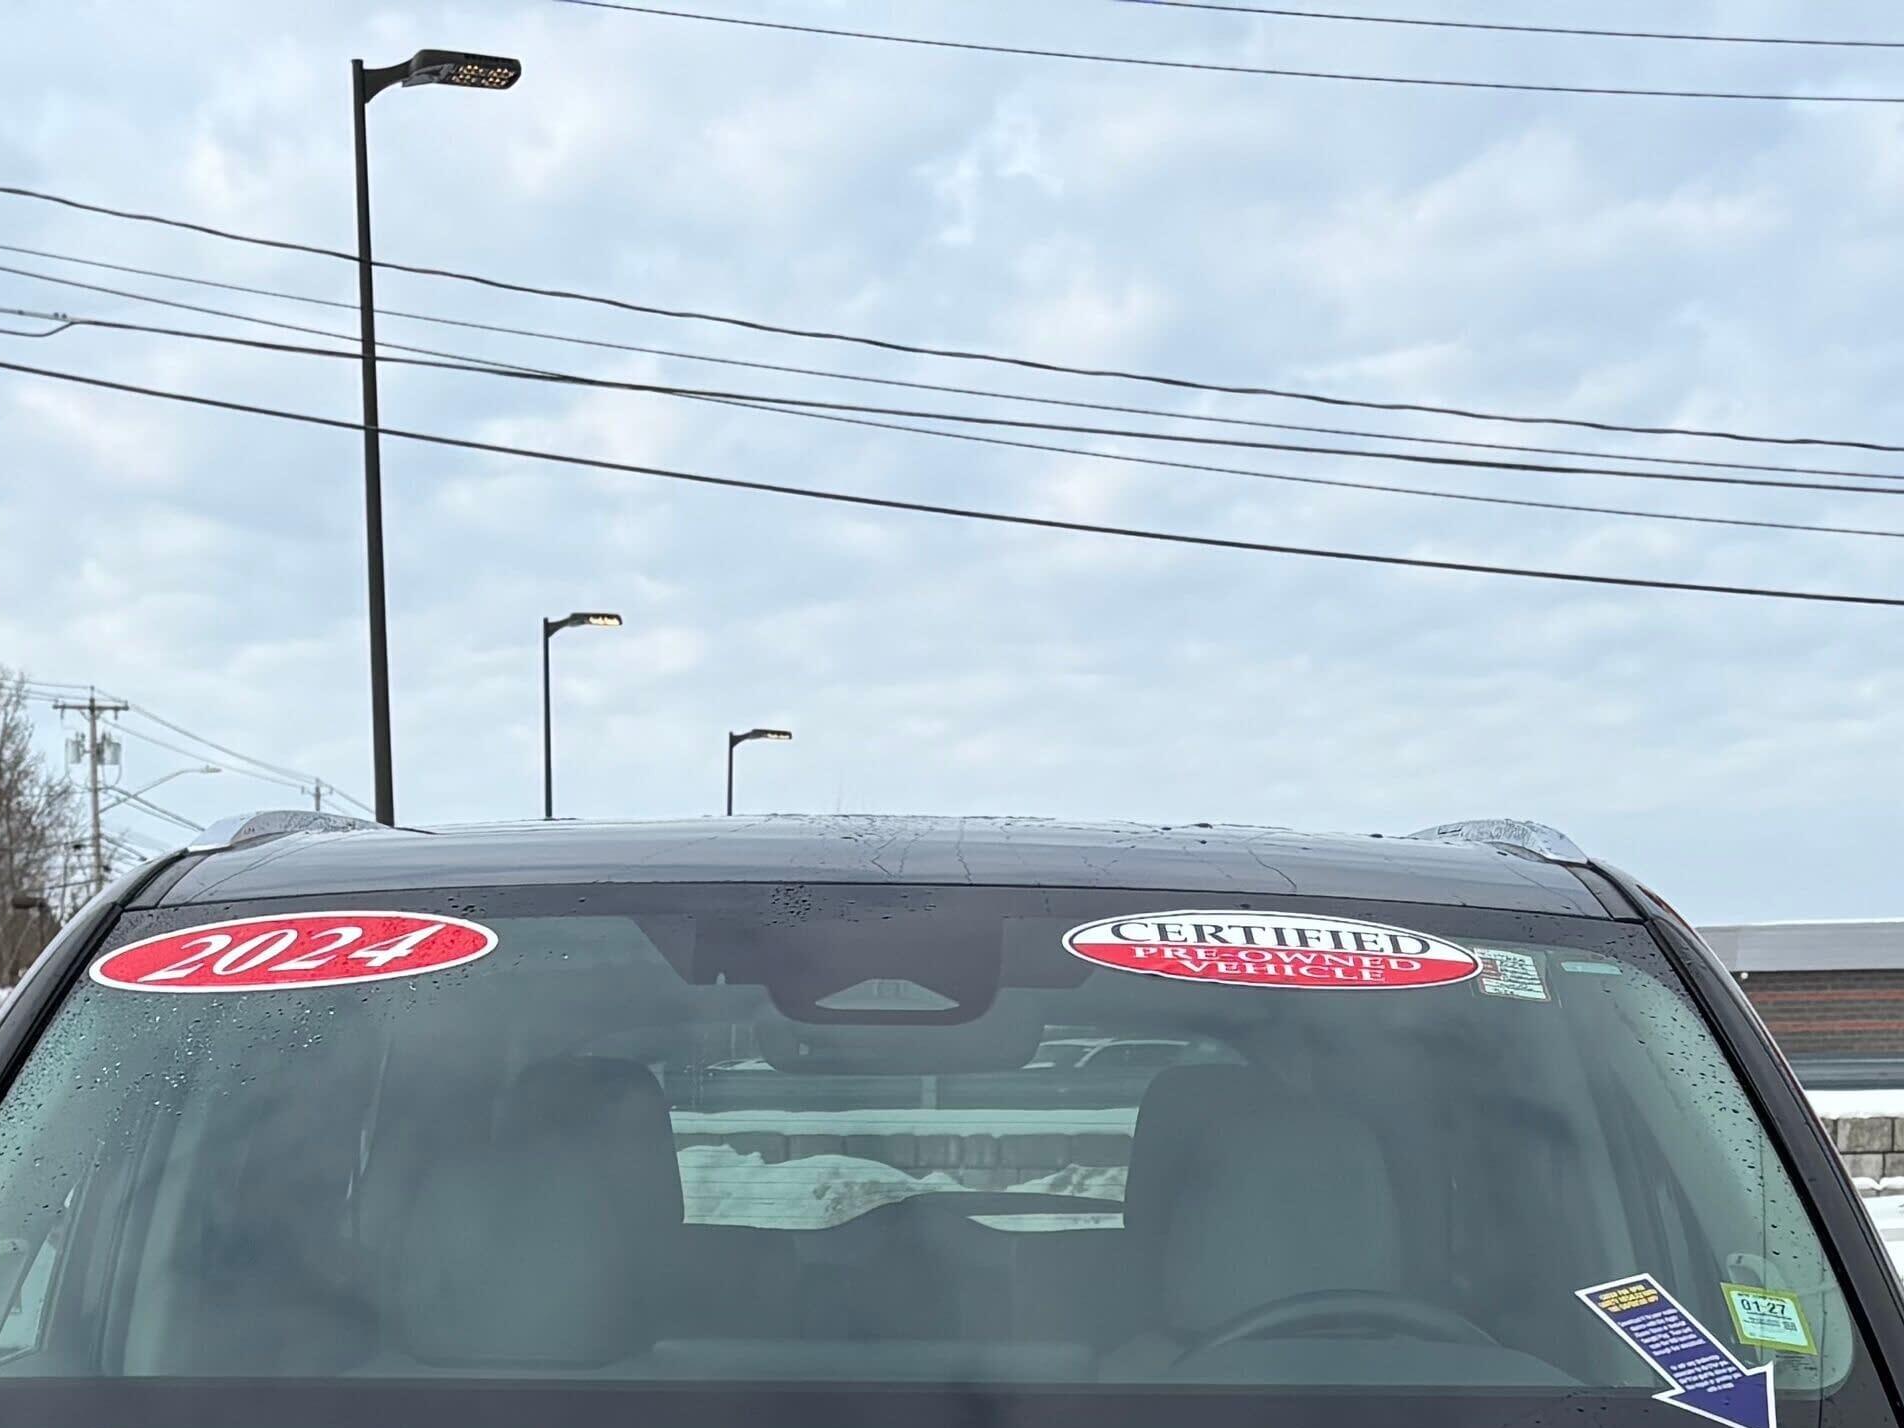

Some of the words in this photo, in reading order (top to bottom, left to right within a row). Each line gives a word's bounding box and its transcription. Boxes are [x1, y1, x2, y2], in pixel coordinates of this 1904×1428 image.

[137, 923, 449, 983] 2024
[1111, 922, 1431, 956] CERTIFIED
[1132, 946, 1422, 971] PRE-OWNED
[1177, 960, 1386, 982] VEHICLE
